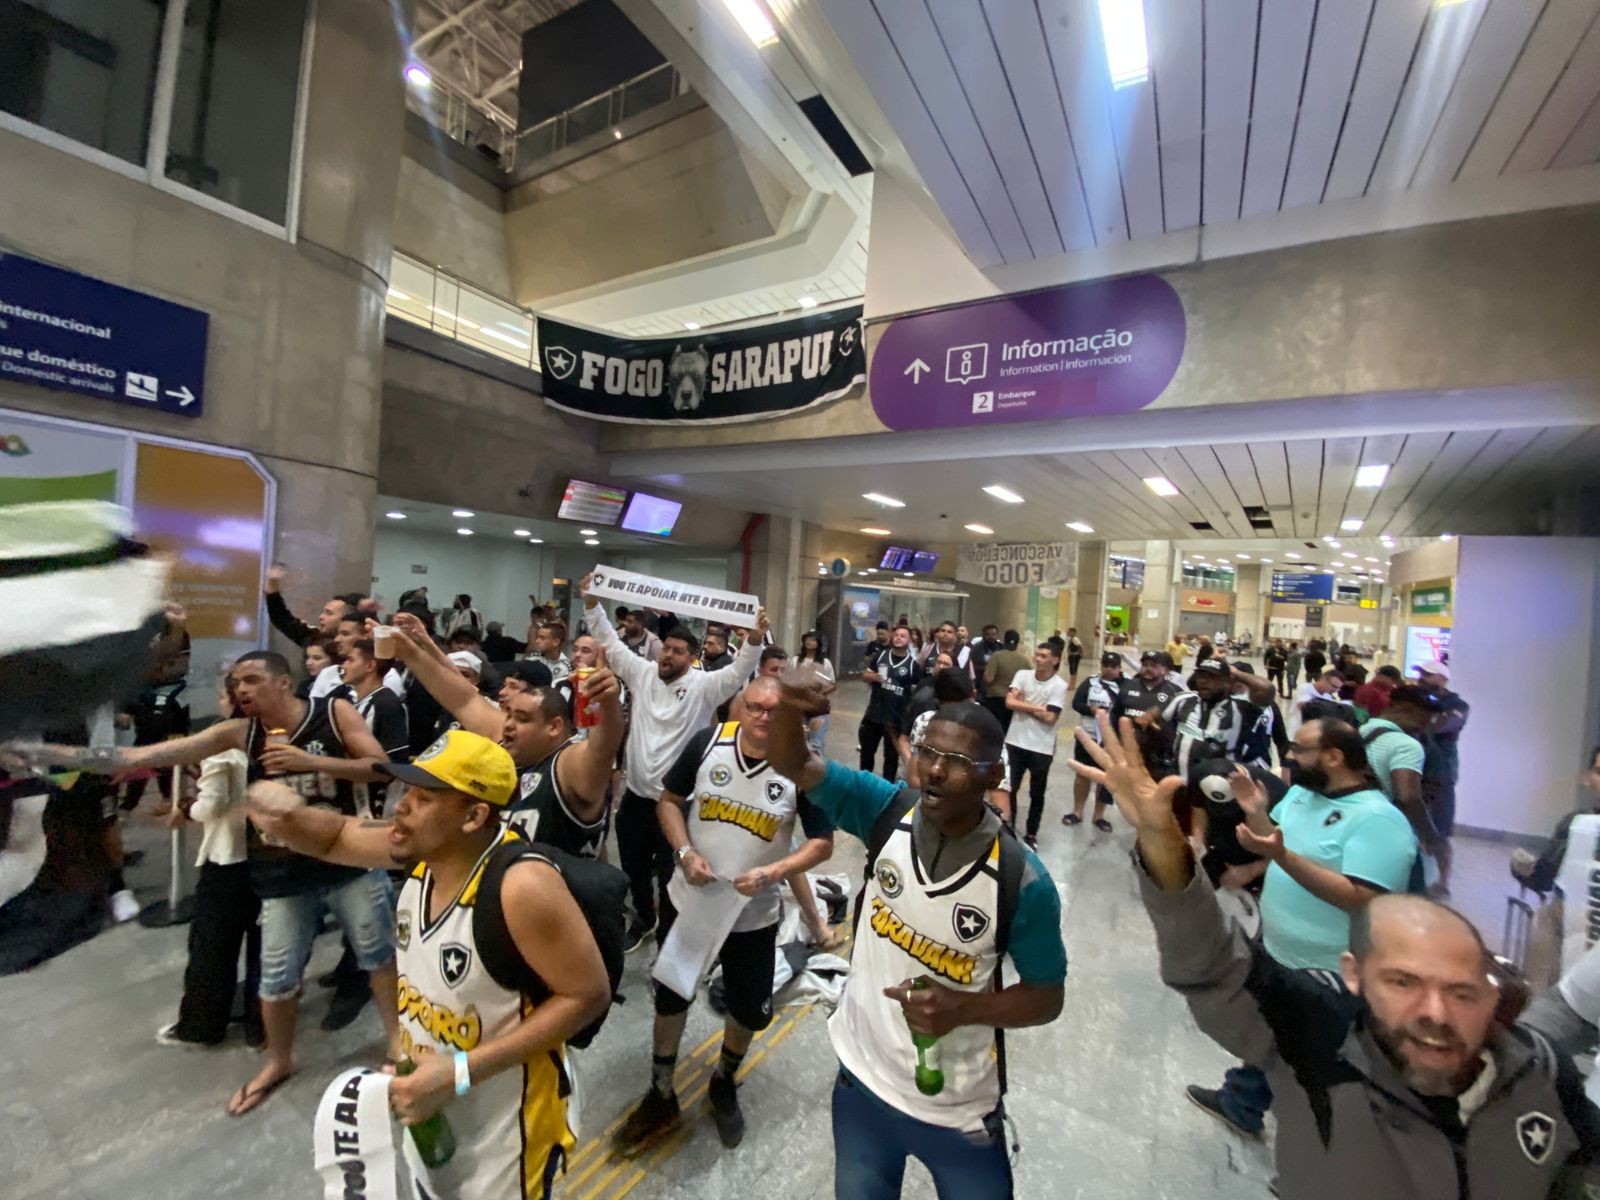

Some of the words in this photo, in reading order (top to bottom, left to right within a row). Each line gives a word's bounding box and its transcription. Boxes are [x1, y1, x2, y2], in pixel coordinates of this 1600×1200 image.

[1001, 328, 1133, 361] Informação
[2, 361, 66, 384] Domestic
[69, 376, 115, 393] arrivals
[27, 350, 117, 379] doméstico
[579, 351, 664, 397] FOGO
[1000, 362, 1056, 377] Information
[1065, 353, 1132, 370] Información
[978, 393, 988, 409] 2
[607, 577, 626, 591] VOU
[627, 582, 637, 592] TE
[636, 584, 677, 600] APOIAR
[709, 597, 756, 616] FINAL
[333, 1130, 360, 1156] TE
